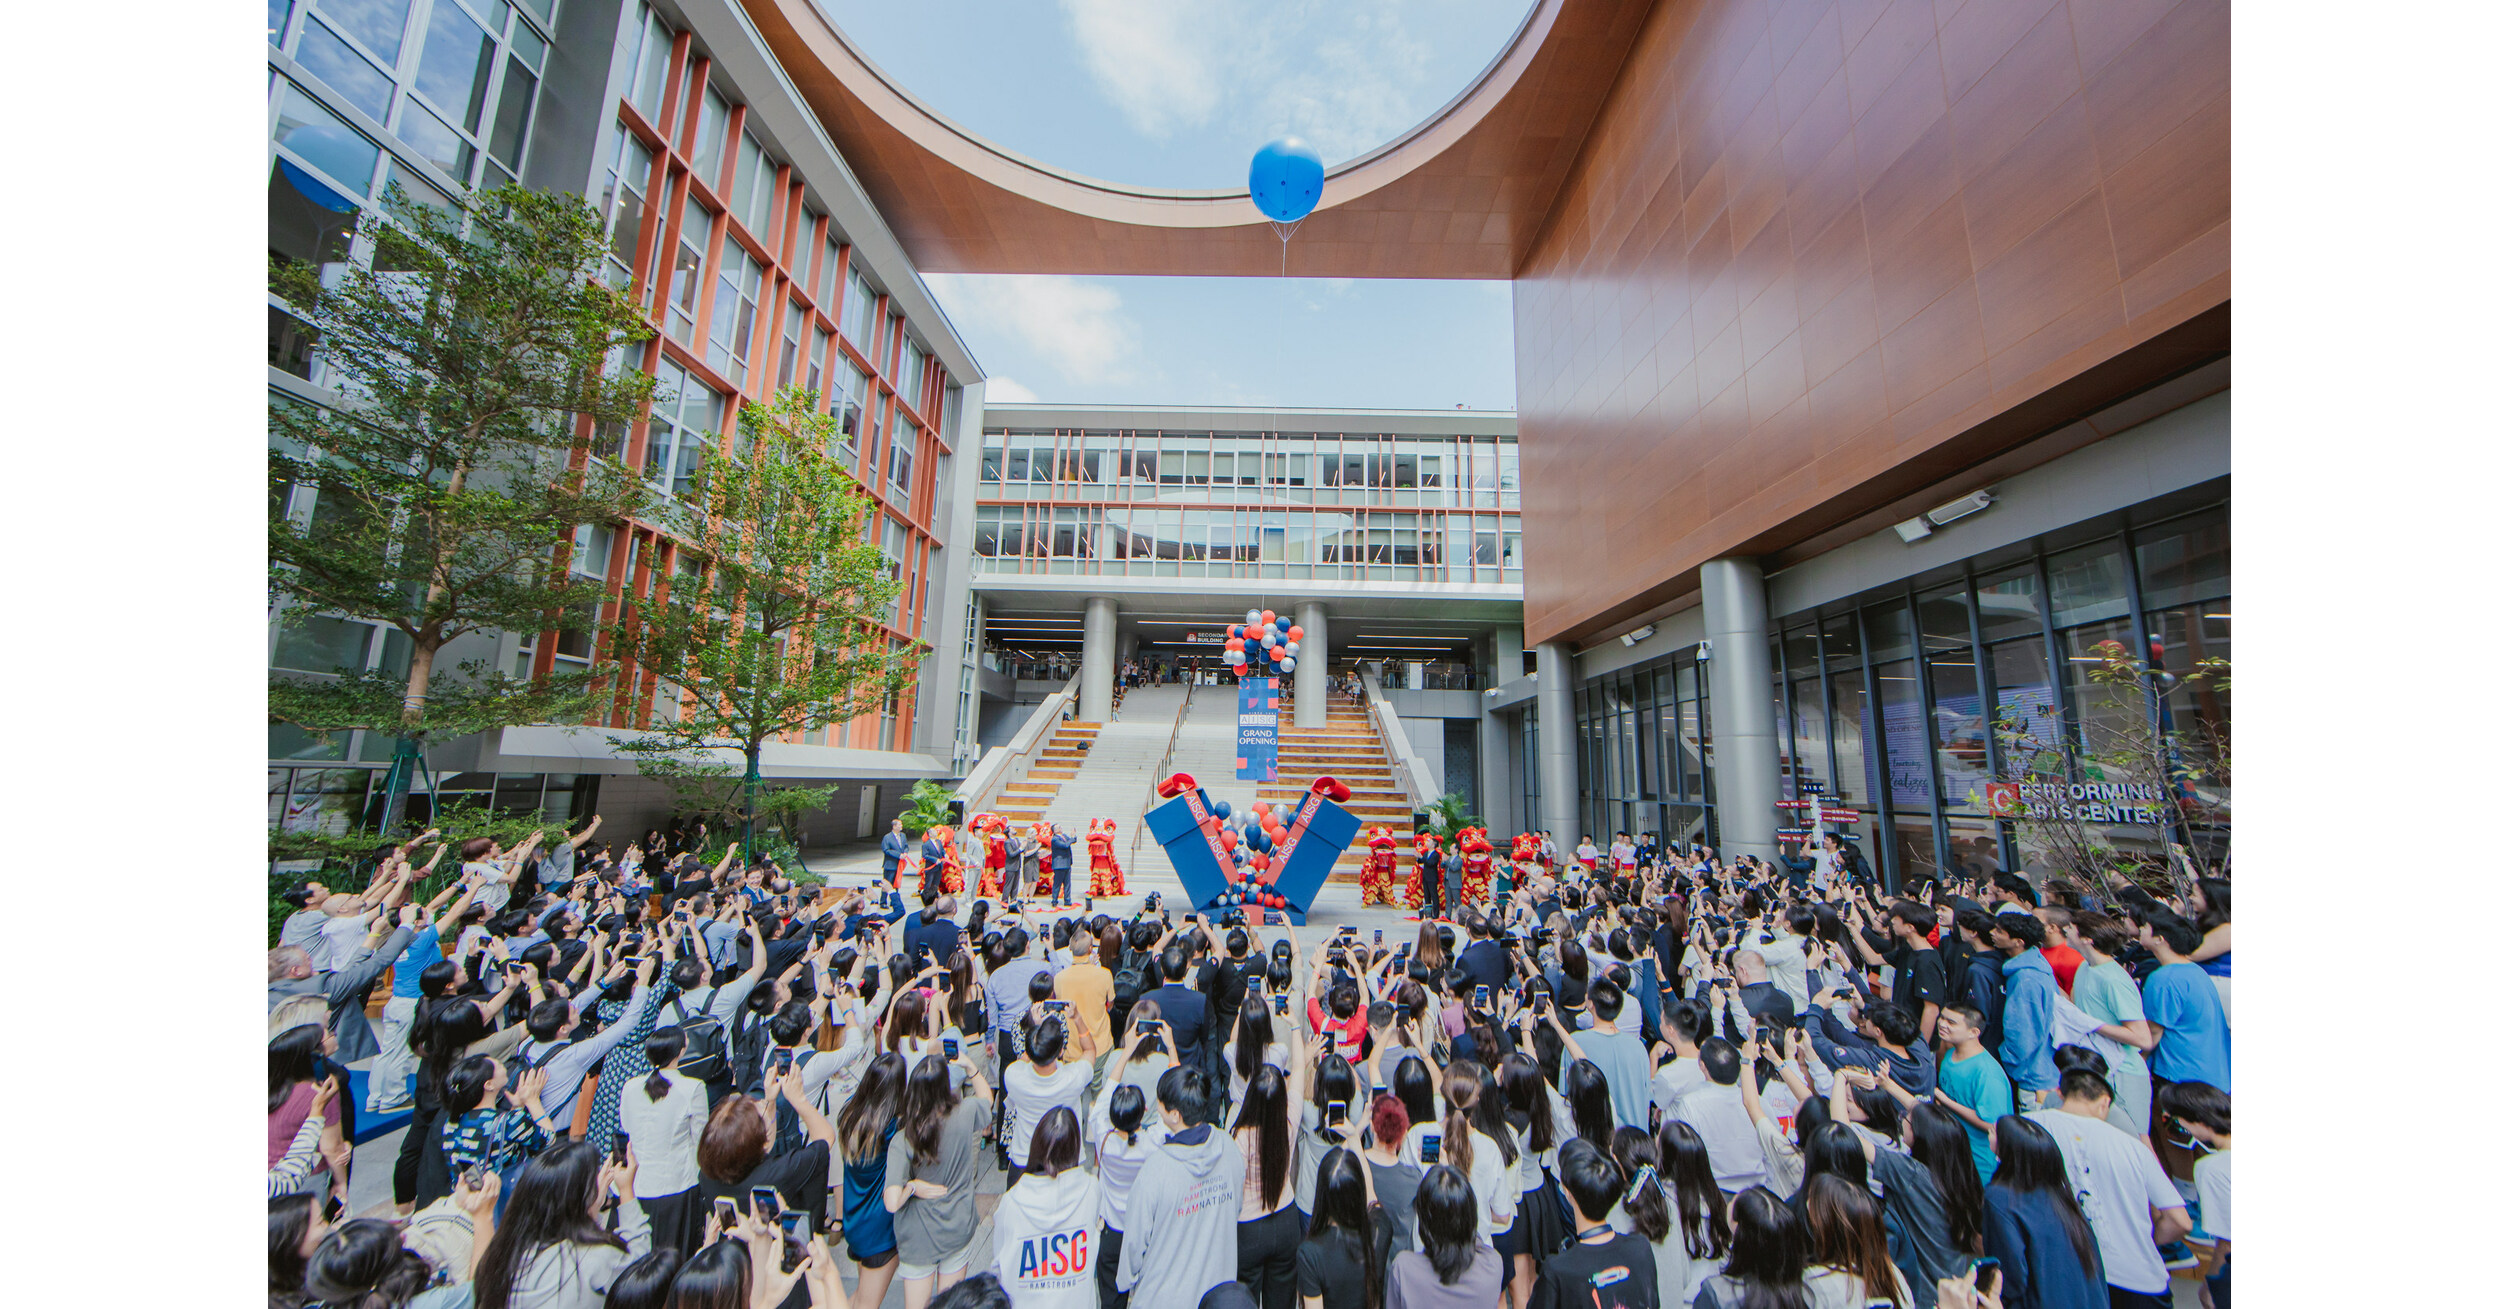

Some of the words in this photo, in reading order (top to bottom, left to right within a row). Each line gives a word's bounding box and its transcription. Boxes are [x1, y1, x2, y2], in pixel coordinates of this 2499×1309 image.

[1240, 715, 1276, 724] AISG
[1186, 795, 1205, 822] AISG
[1301, 797, 1321, 824] AISG
[1993, 789, 2013, 811] C
[1207, 835, 1226, 861] AISG
[1278, 837, 1298, 864] AISG
[1177, 1191, 1232, 1217] RAMNATION
[1019, 1229, 1087, 1278] AISG
[1030, 1279, 1076, 1290] RAMSTRONG
